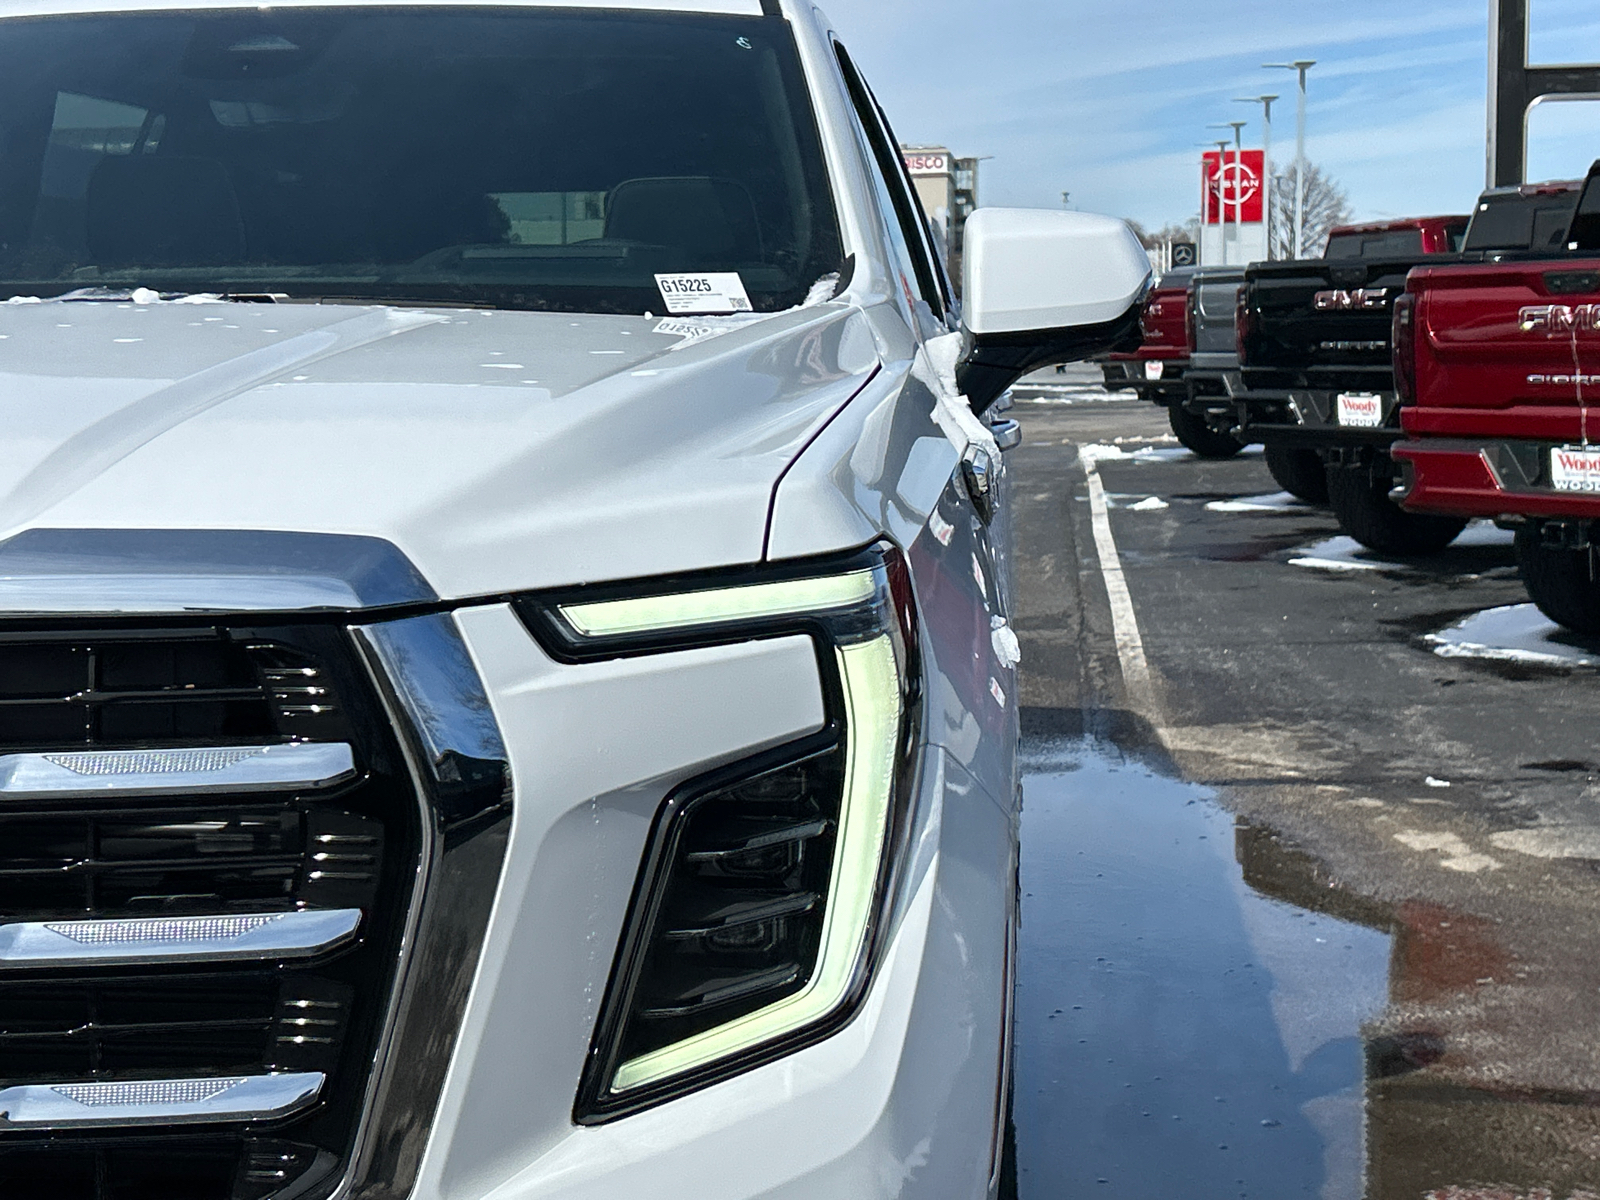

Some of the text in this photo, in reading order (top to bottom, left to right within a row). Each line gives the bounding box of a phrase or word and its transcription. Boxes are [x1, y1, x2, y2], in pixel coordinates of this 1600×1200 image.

[660, 279, 712, 293] G15225
[1518, 303, 1600, 331] GM
[1342, 398, 1377, 416] Woody
